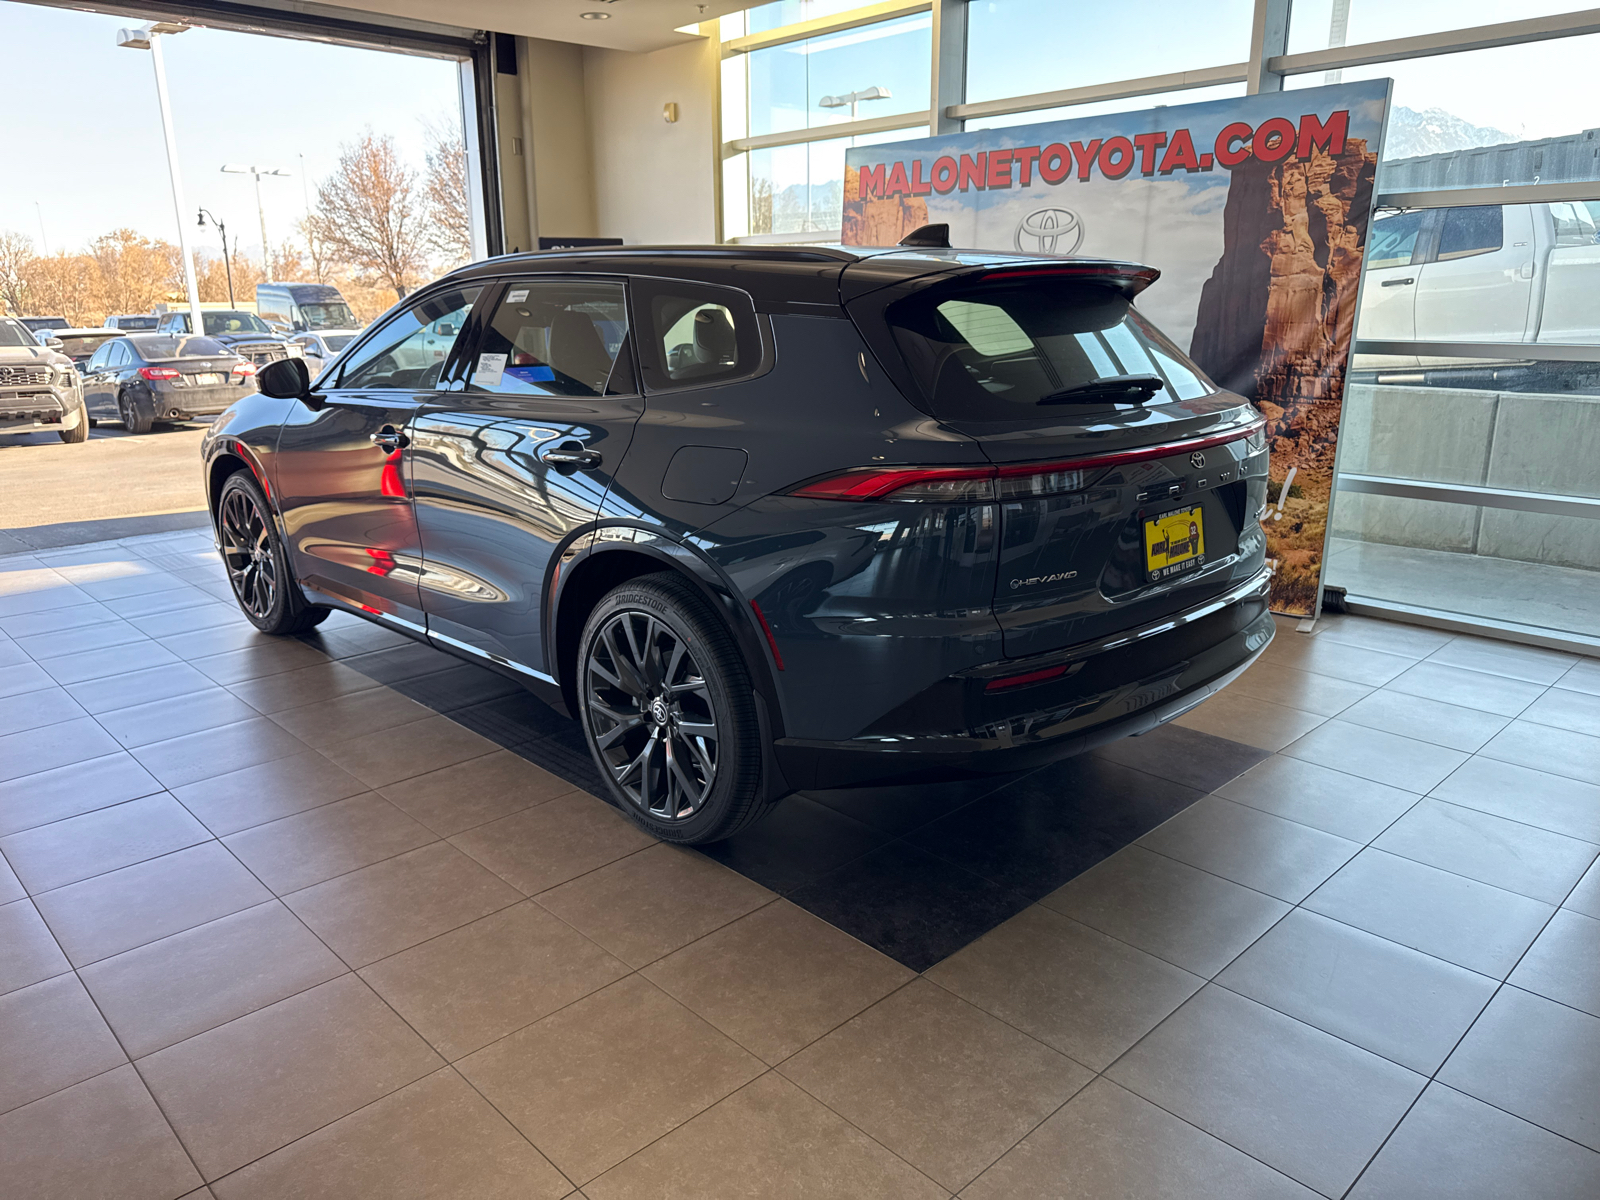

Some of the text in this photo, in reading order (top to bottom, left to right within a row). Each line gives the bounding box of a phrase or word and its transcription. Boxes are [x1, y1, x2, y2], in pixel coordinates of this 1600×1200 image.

[858, 109, 1349, 201] MALONETOYOTA.COM
[1190, 526, 1197, 535] 32
[1162, 567, 1170, 576] WE
[1170, 563, 1181, 574] MAKE
[615, 594, 668, 615] BRIDGESTONE
